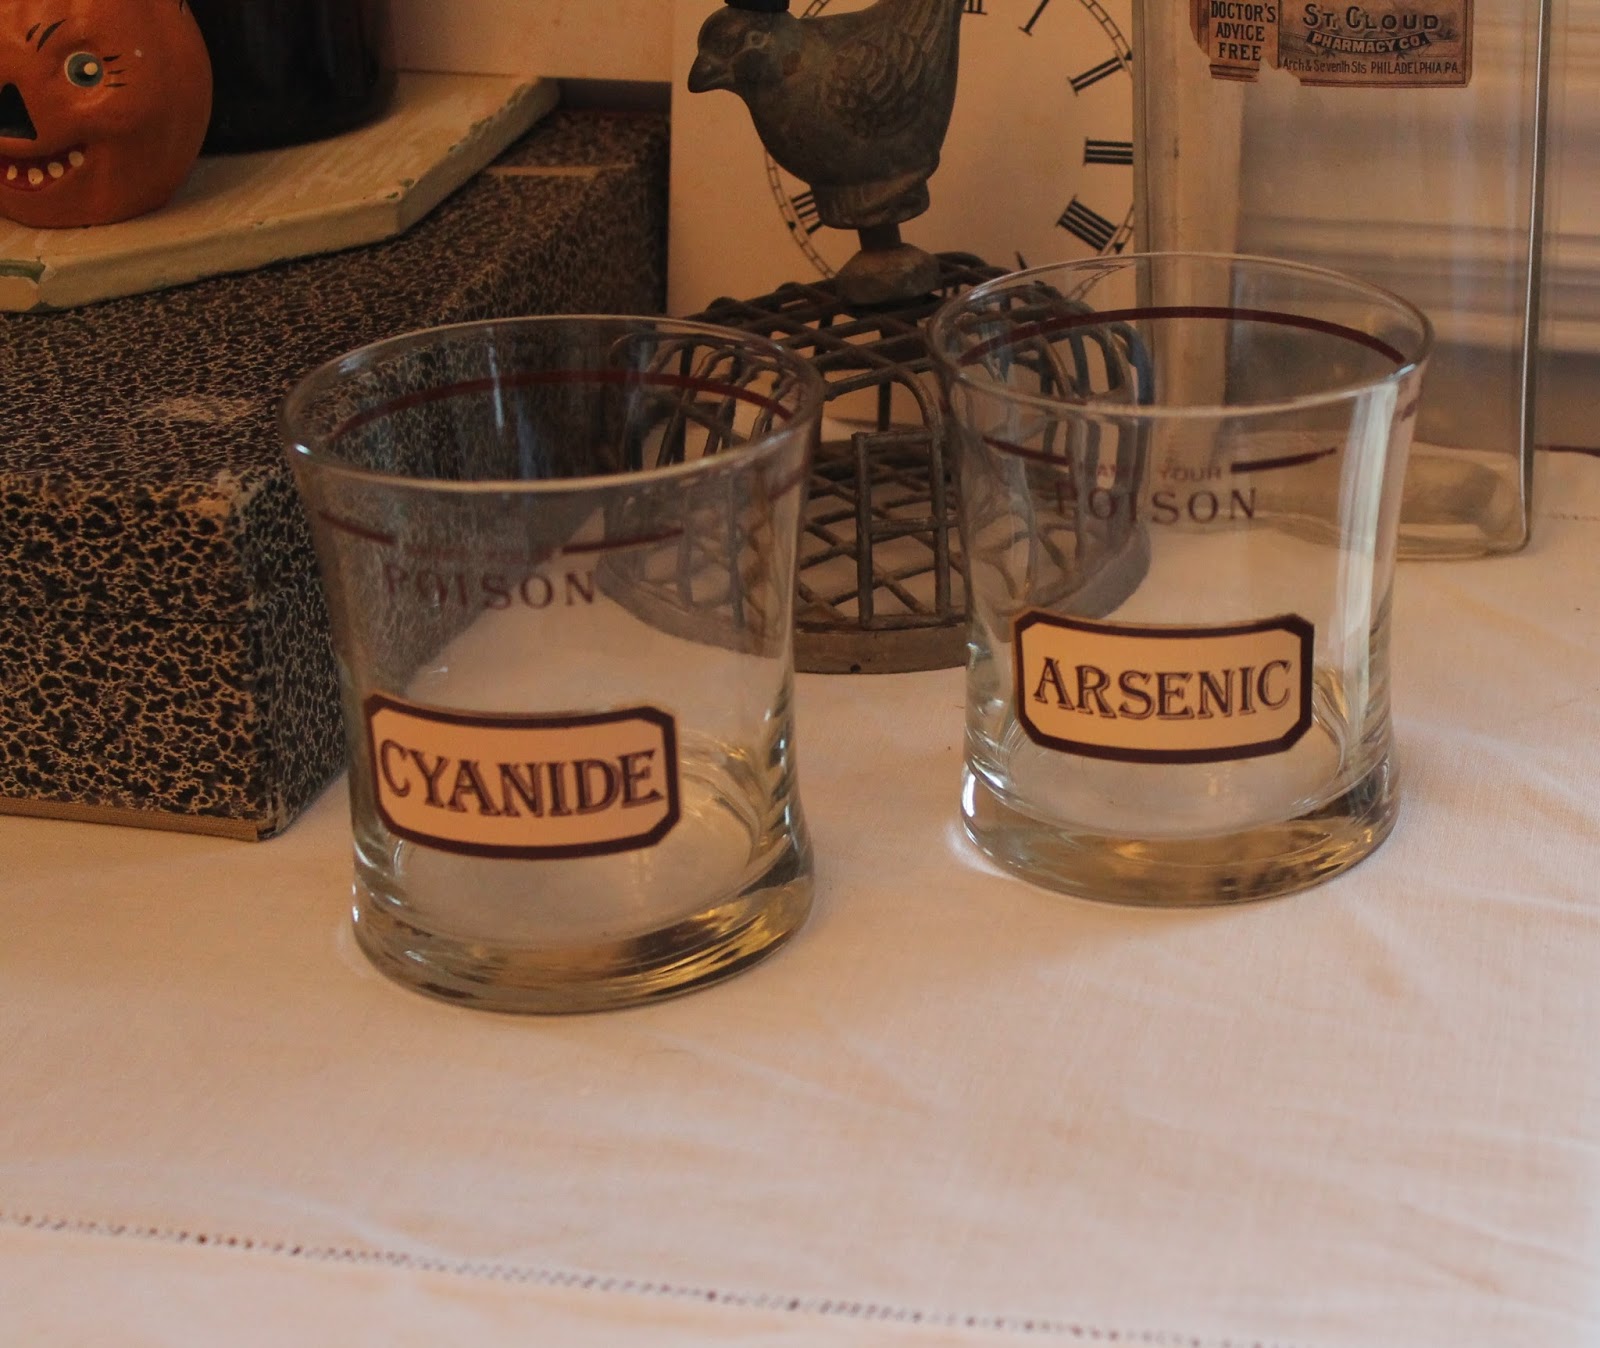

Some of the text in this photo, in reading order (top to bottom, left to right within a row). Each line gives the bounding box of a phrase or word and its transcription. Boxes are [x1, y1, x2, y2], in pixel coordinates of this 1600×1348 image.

[1210, 1, 1276, 23] DOCTOR'S
[1215, 22, 1265, 42] ADVICE
[1312, 33, 1395, 53] PHARMACY
[1218, 42, 1262, 61] FREE
[1283, 58, 1304, 72] Arch
[1304, 59, 1312, 72] &
[1054, 480, 1256, 524] POISON
[383, 562, 597, 610] POISON
[1033, 656, 1292, 721] ARSENIC
[380, 738, 664, 818] CYANIDE
